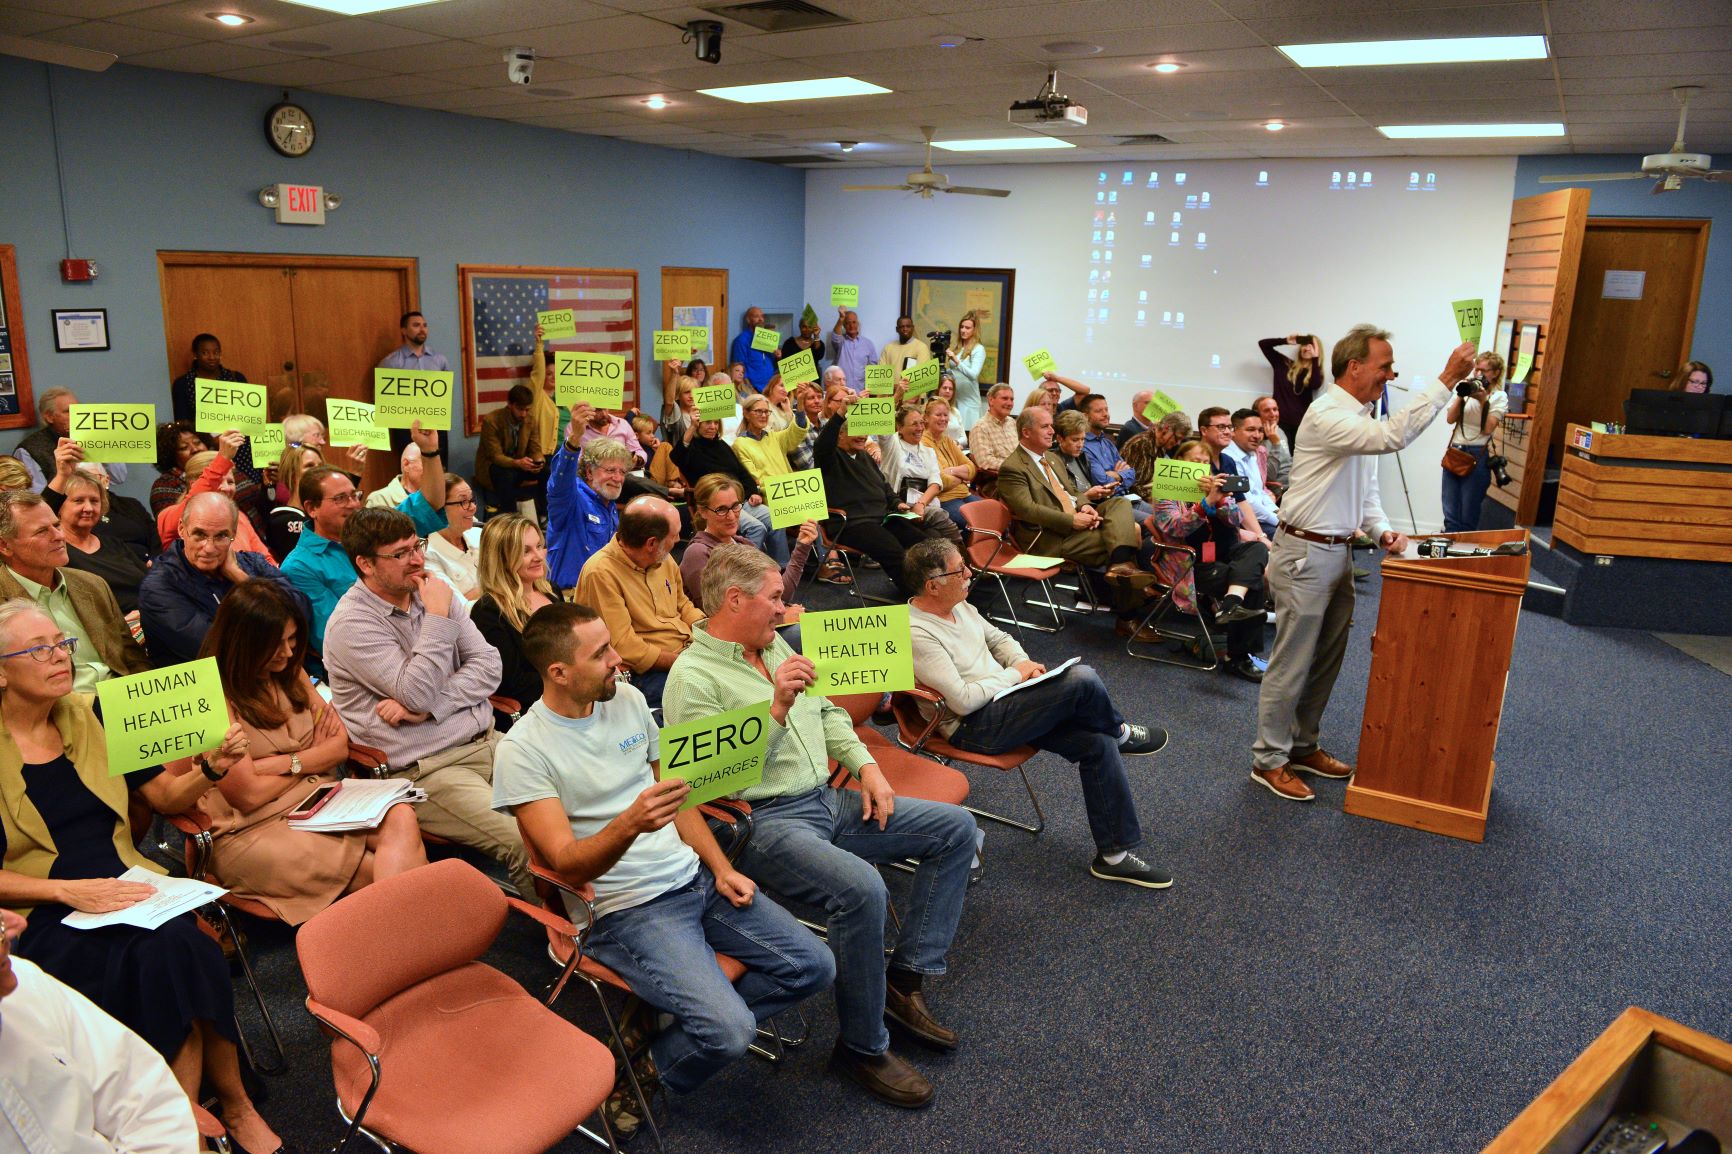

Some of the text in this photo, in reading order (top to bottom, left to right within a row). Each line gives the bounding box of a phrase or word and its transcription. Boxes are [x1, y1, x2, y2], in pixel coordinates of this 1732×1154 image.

[288, 186, 317, 213] EXIT
[832, 288, 857, 296] ZERO
[541, 313, 572, 325] ZERO
[656, 335, 689, 345] ZERO
[756, 330, 778, 342] ZERO
[781, 353, 811, 374] ZERO
[1025, 351, 1050, 368] ZERO
[559, 359, 620, 379] ZERO
[867, 368, 893, 379] ZERO
[906, 364, 938, 384] ZERO
[380, 376, 448, 398] ZERO
[559, 385, 620, 397] DISCHARGES
[200, 386, 262, 408] ZERO
[696, 388, 733, 404] ZERO
[380, 405, 448, 417] DISCHARGES
[850, 402, 892, 416] ZERO
[75, 412, 150, 431] ZERO
[200, 411, 263, 425] DISCHARGES
[850, 420, 893, 428] DISCHARGES
[333, 427, 387, 440] DISCHARGES
[76, 440, 152, 449] DISCHARGES
[1158, 464, 1206, 481] ZERO
[769, 476, 820, 500] ZERO
[774, 500, 824, 517] DISCHARGES
[823, 614, 887, 632] HUMAN
[818, 640, 897, 659] HEALTH &
[126, 670, 197, 700] HUMAN
[830, 669, 888, 686] SAFETY
[123, 698, 211, 732] HEALTH &
[139, 729, 205, 760] SAFETY
[668, 716, 762, 769] ZERO
[685, 756, 759, 789] SCHARGES
